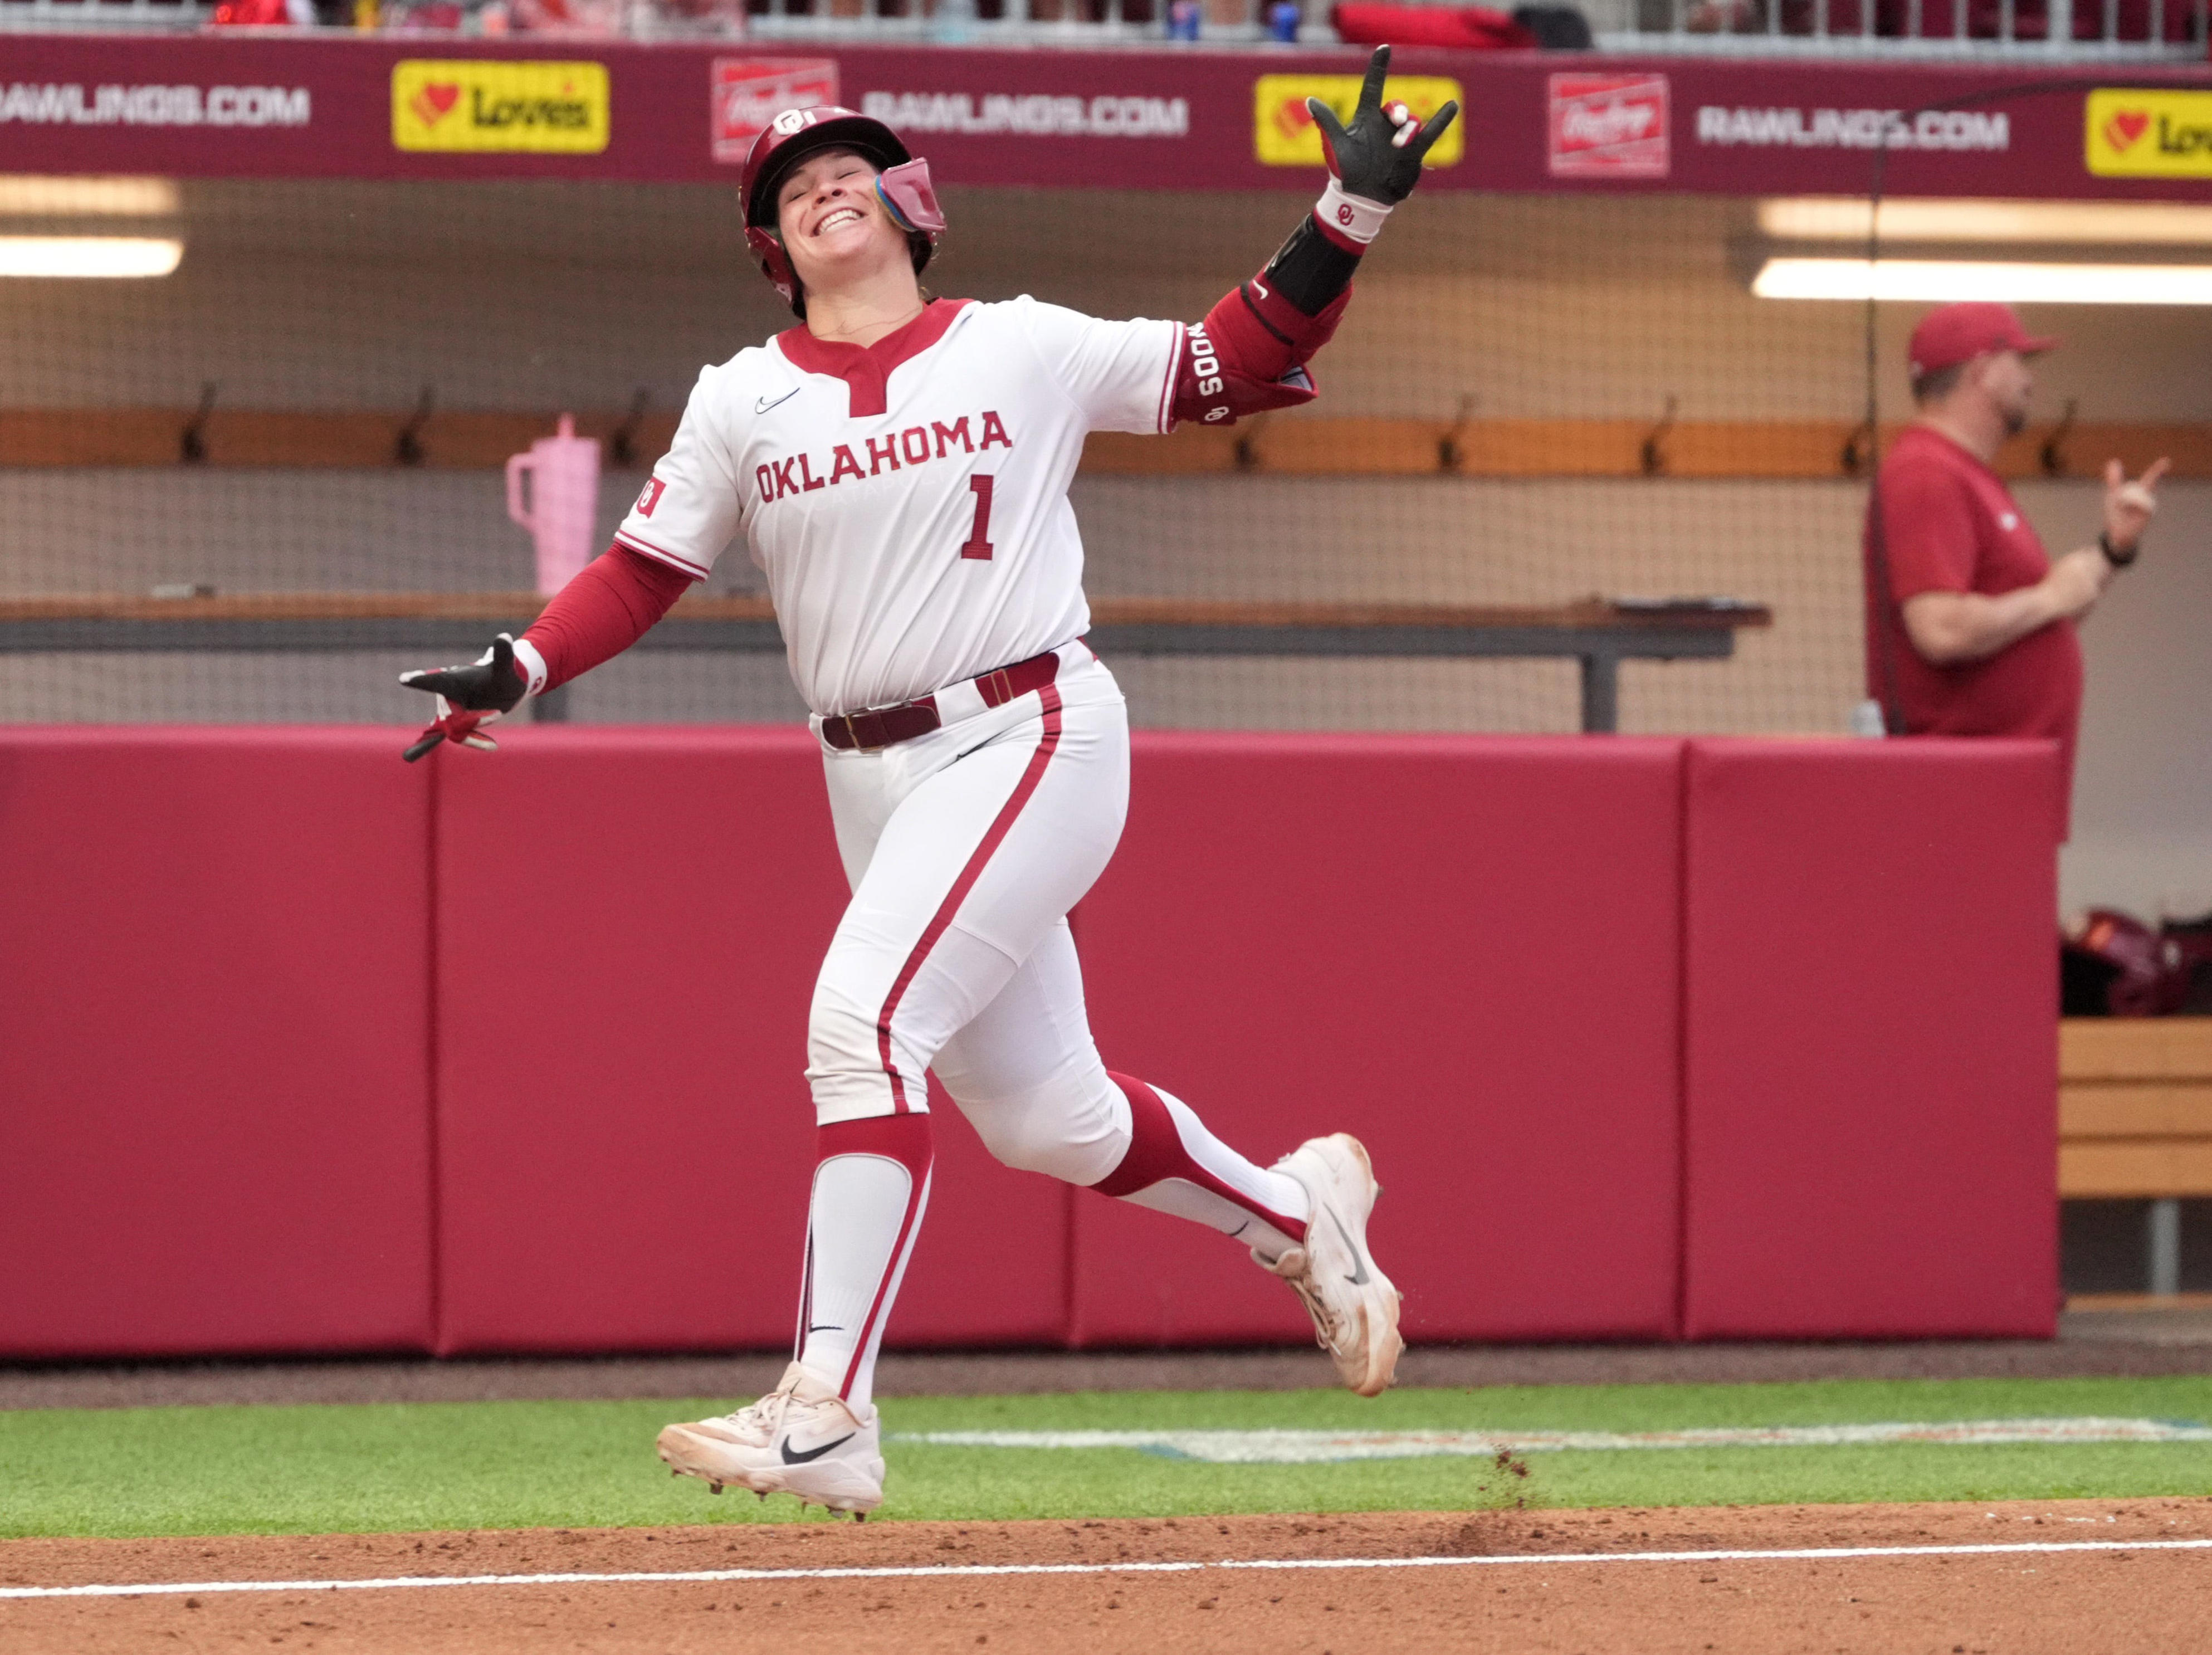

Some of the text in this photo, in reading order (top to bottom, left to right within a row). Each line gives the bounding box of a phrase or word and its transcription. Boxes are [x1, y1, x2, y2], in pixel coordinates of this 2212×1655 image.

[0, 82, 310, 125] AWLINGS.COM
[861, 91, 1190, 136] RAWLINGS.COM
[1697, 105, 2009, 151] RAWLINGS.COM
[1337, 203, 1355, 226] OU
[756, 410, 1013, 503] OKLAHOMA
[961, 473, 994, 560] 1
